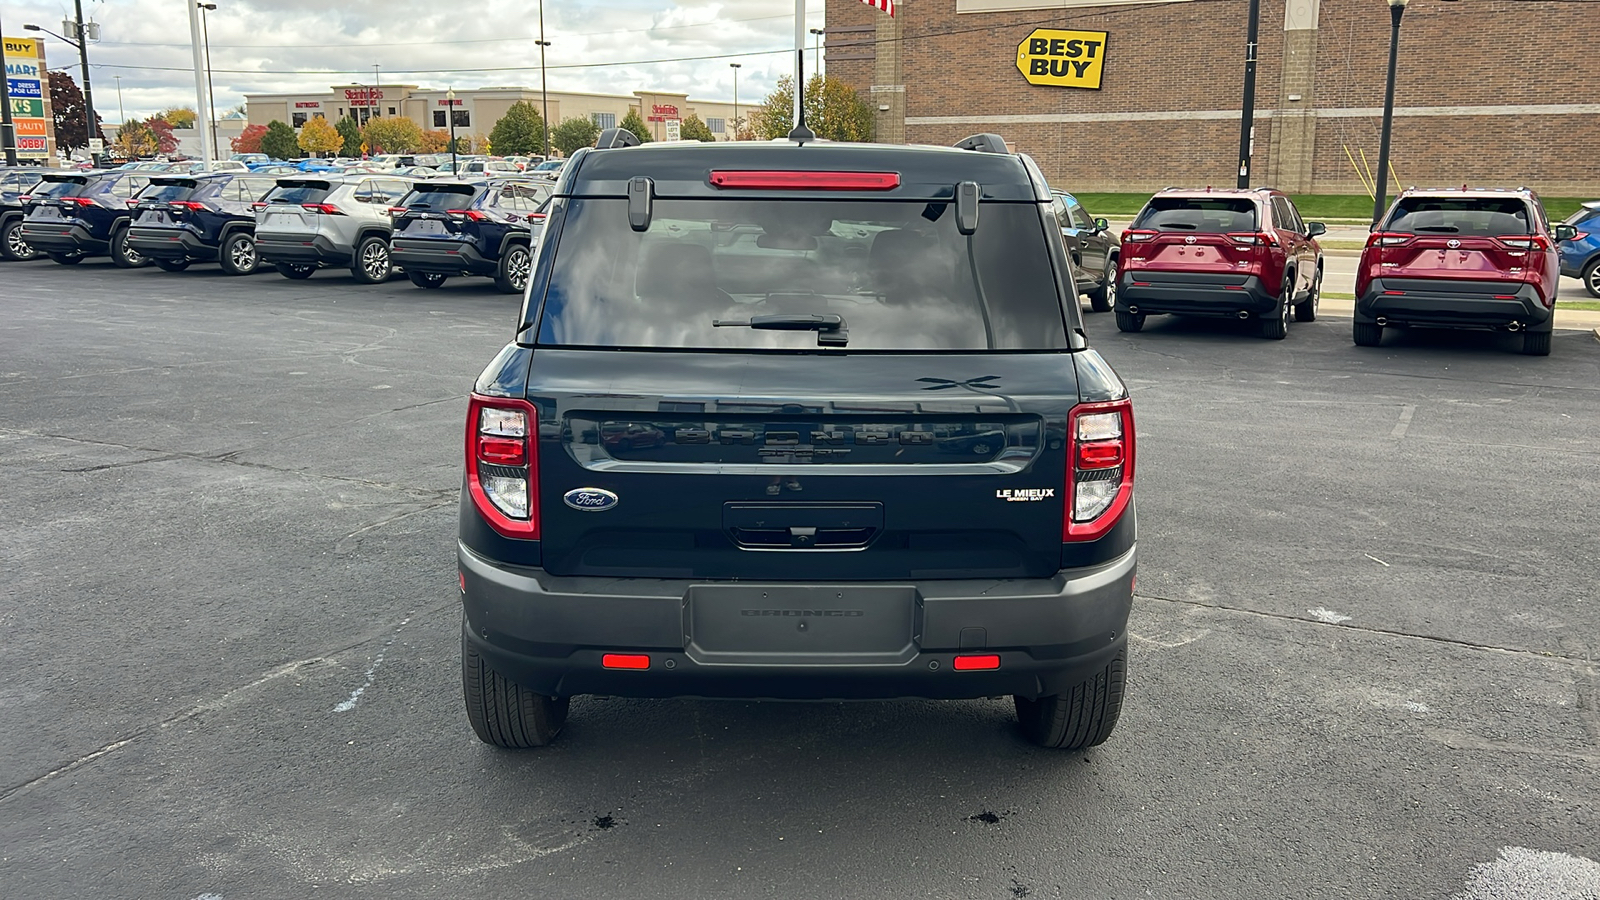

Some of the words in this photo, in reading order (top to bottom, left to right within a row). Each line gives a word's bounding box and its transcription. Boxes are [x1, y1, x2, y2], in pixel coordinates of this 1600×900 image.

[5, 43, 32, 52] BUY
[1029, 38, 1102, 58] BEST
[5, 64, 37, 76] MART
[1029, 58, 1092, 78] BUY
[17, 138, 45, 149] LOBBY
[675, 430, 934, 446] BRONCO
[758, 448, 852, 458] SPORT
[575, 492, 605, 505] Ford
[996, 489, 1012, 498] LE
[1014, 488, 1055, 498] MIEUX
[741, 609, 864, 617] BRONCO
